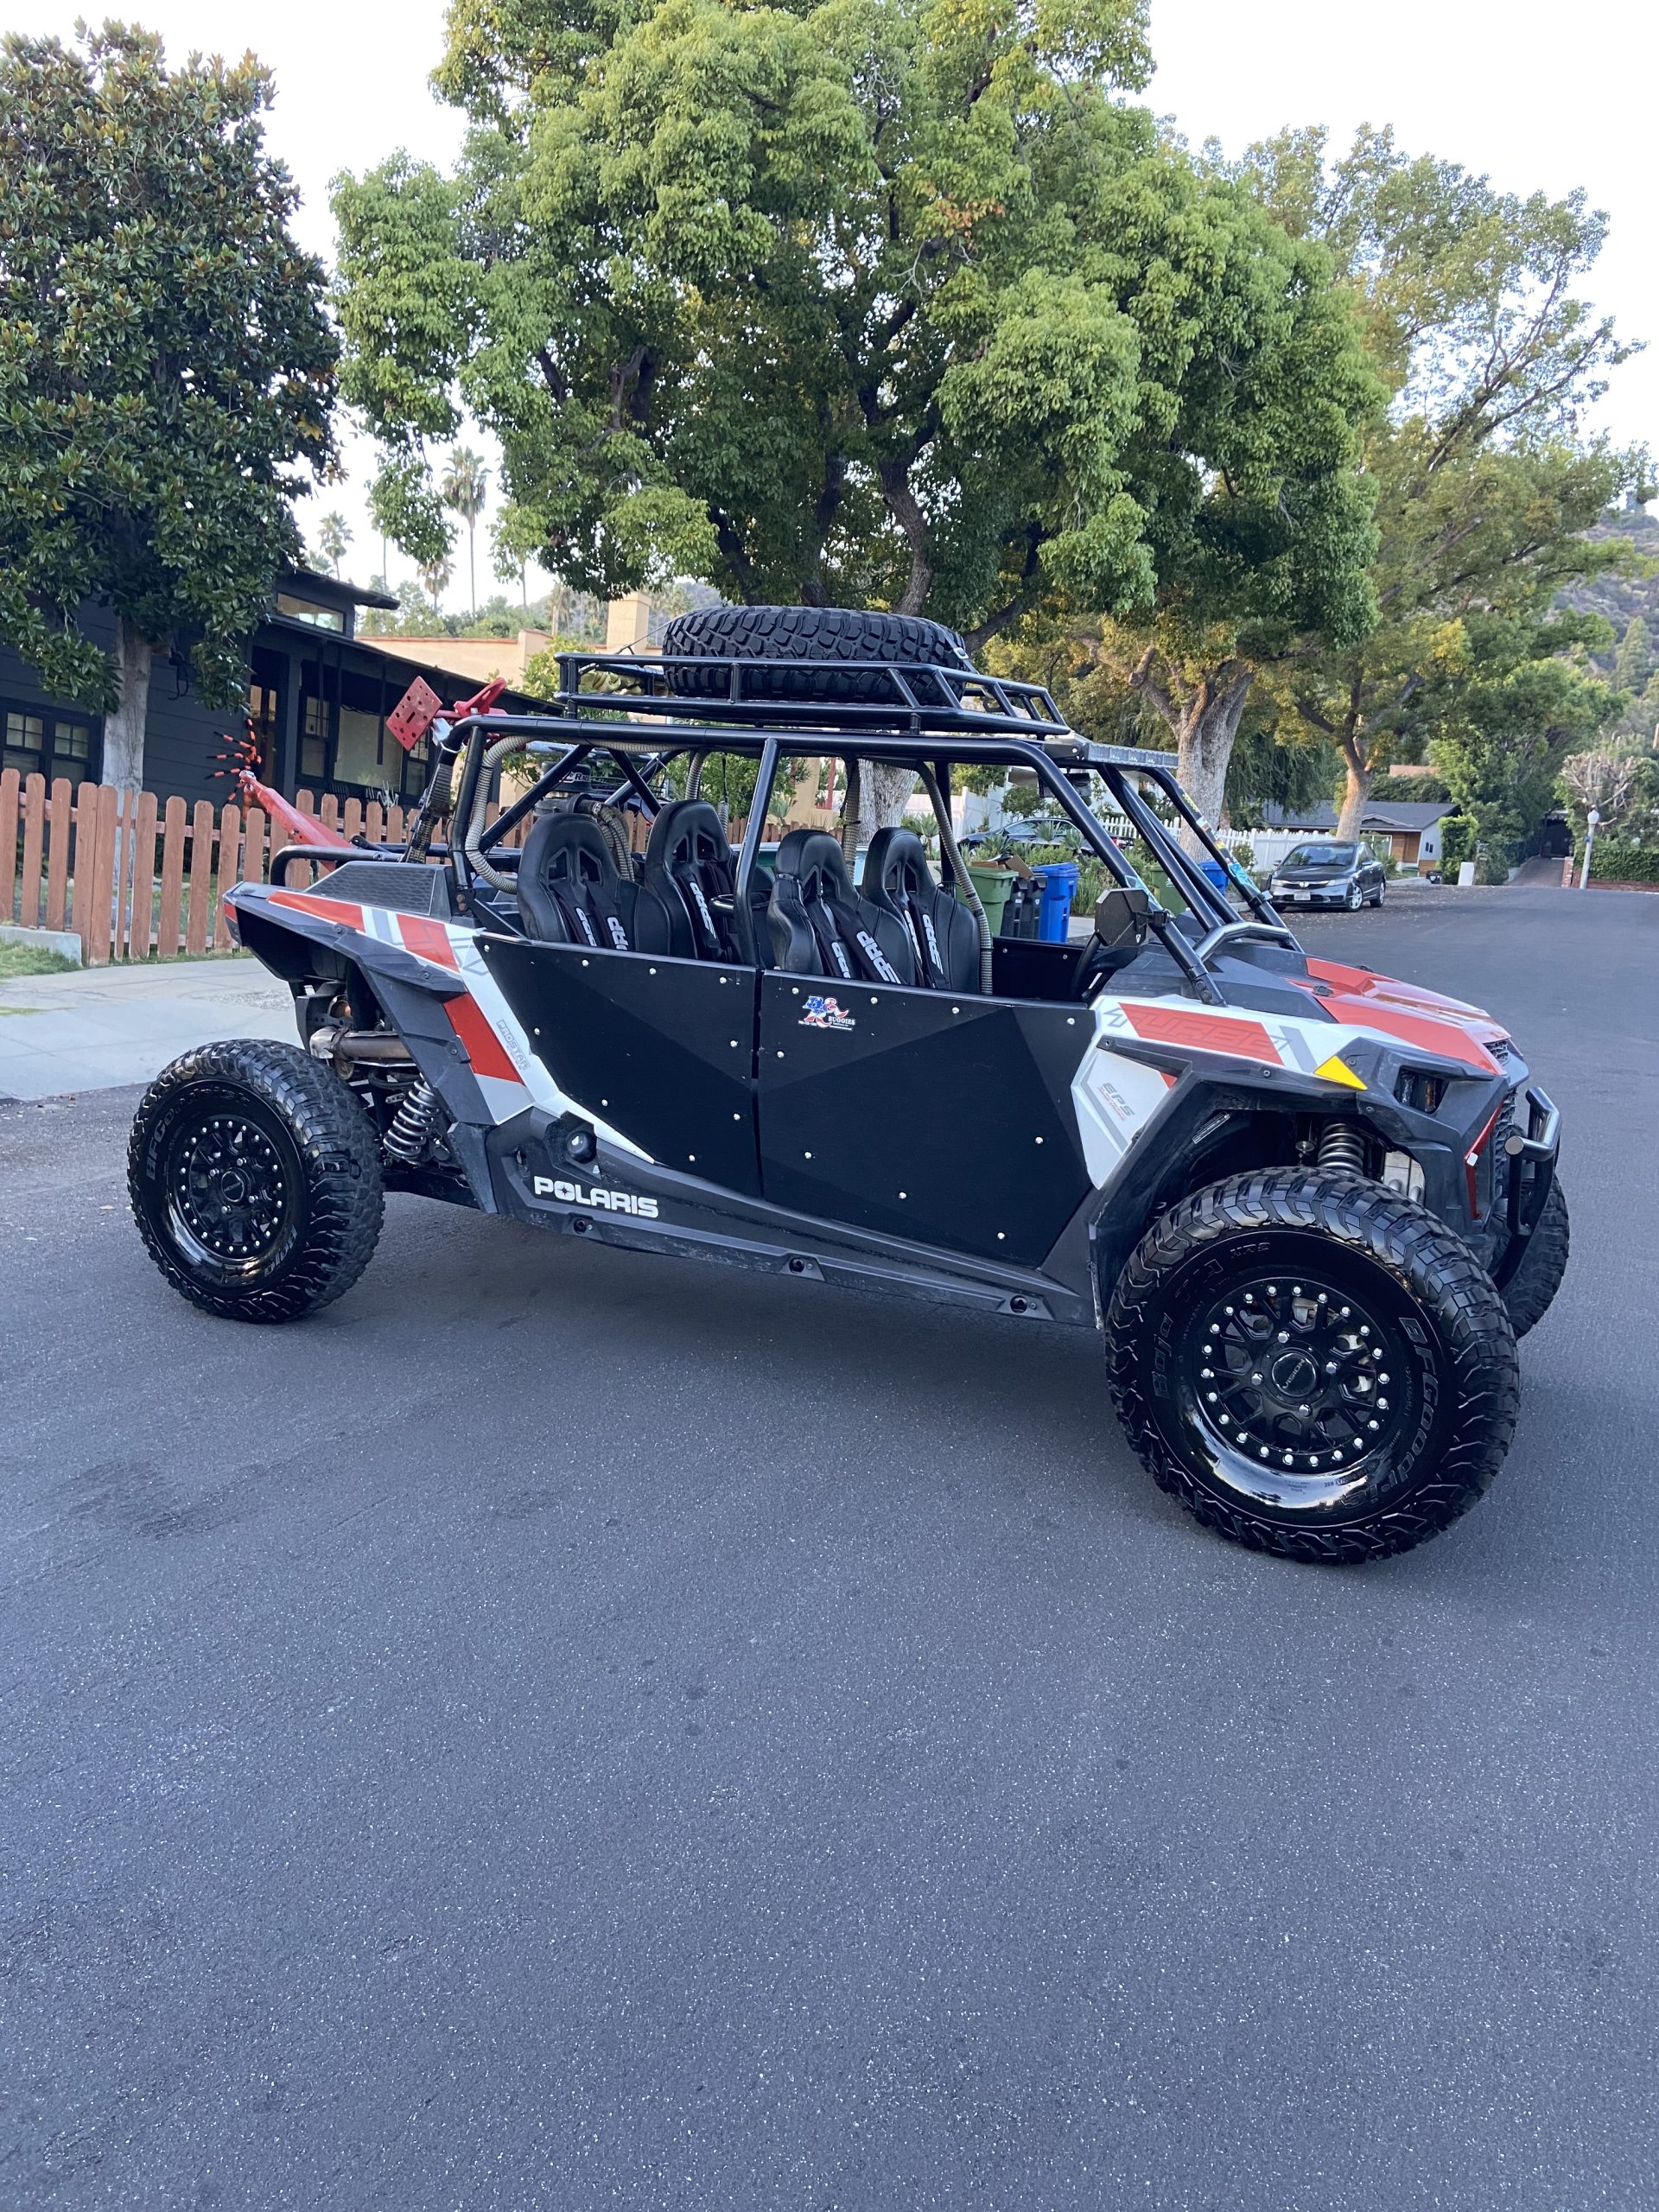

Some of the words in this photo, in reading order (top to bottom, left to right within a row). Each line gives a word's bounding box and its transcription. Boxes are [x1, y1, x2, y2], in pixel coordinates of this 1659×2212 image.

[856, 931, 901, 984] PRP
[496, 1020, 531, 1070] PROSTAR
[1103, 1083, 1135, 1116] EPS
[534, 1176, 658, 1218] POLARIS
[1151, 1312, 1174, 1401] Baja
[1282, 1358, 1306, 1389] VISION
